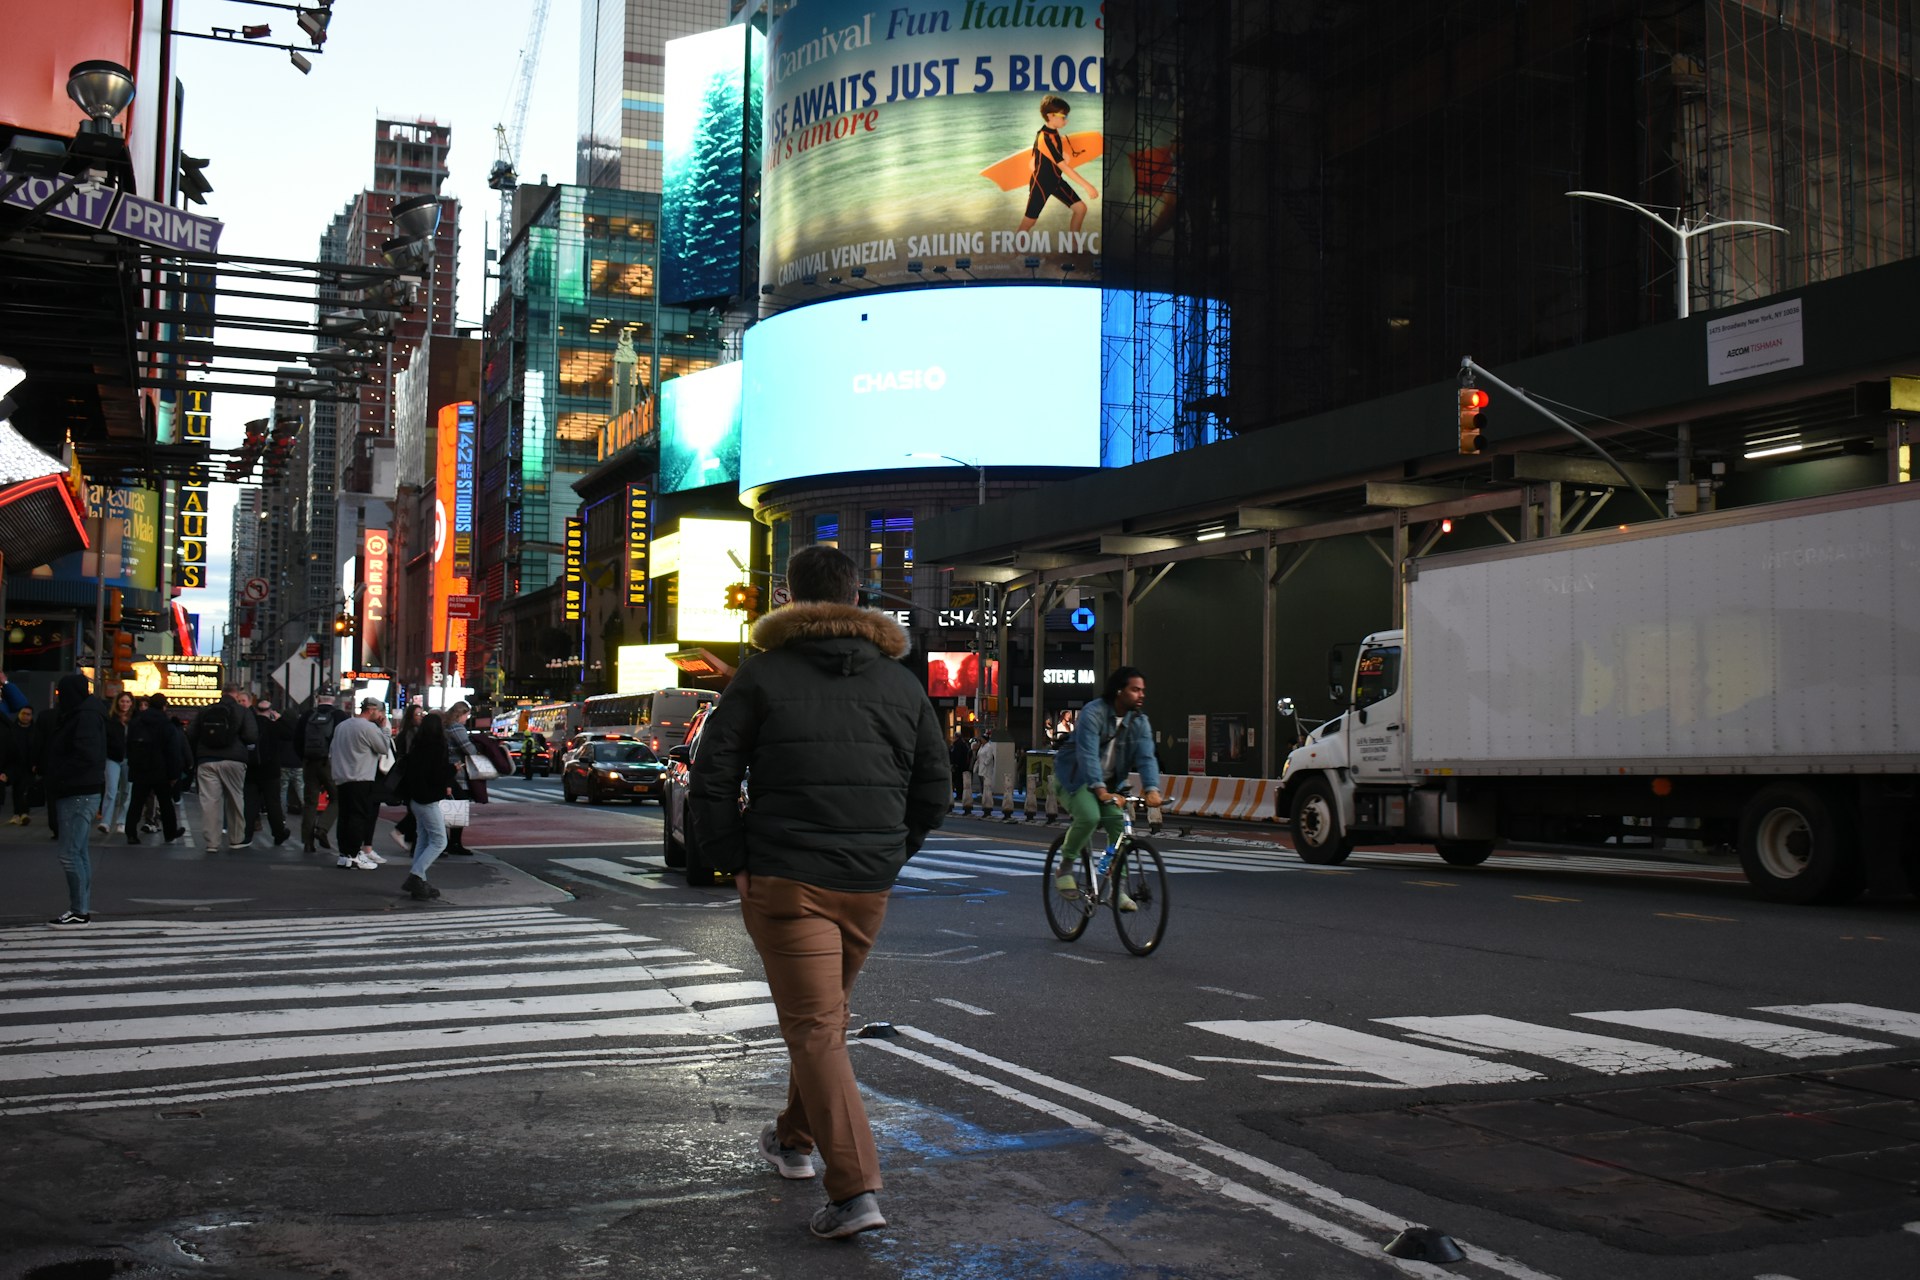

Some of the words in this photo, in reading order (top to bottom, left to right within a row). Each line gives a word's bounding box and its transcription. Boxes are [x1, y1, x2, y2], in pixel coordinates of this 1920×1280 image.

[886, 7, 952, 40] Fun
[960, 0, 1087, 30] Italian
[775, 13, 872, 83] Carnival
[792, 70, 877, 132] AWAITS
[887, 58, 959, 102] JUST
[973, 56, 994, 93] 5
[1009, 55, 1105, 93] BLOC
[798, 109, 879, 153] amore
[0, 174, 104, 220] RONT
[126, 201, 213, 250] PRIME
[778, 251, 828, 286] CARNIVAL
[831, 238, 897, 269] VENEZIA
[907, 233, 984, 258] SAILING
[991, 231, 1051, 253] FROM
[1058, 231, 1100, 255] NYC
[1722, 321, 1747, 332] Broadway
[1748, 318, 1760, 326] New
[1761, 313, 1774, 322] York,
[1775, 310, 1783, 318] NY
[1727, 346, 1750, 358] AECOM
[1751, 338, 1783, 352] TISHMAN
[458, 435, 474, 463] 42
[455, 480, 474, 532] STUDIOS
[632, 488, 647, 559] VICTORY
[133, 513, 154, 543] Mala
[455, 538, 470, 568] DUE
[568, 520, 582, 581] VICTORY
[368, 559, 383, 621] REGAL
[566, 590, 580, 620] NEW
[630, 570, 645, 603] NEW
[431, 661, 443, 685] rget
[1043, 669, 1076, 684] STEVE
